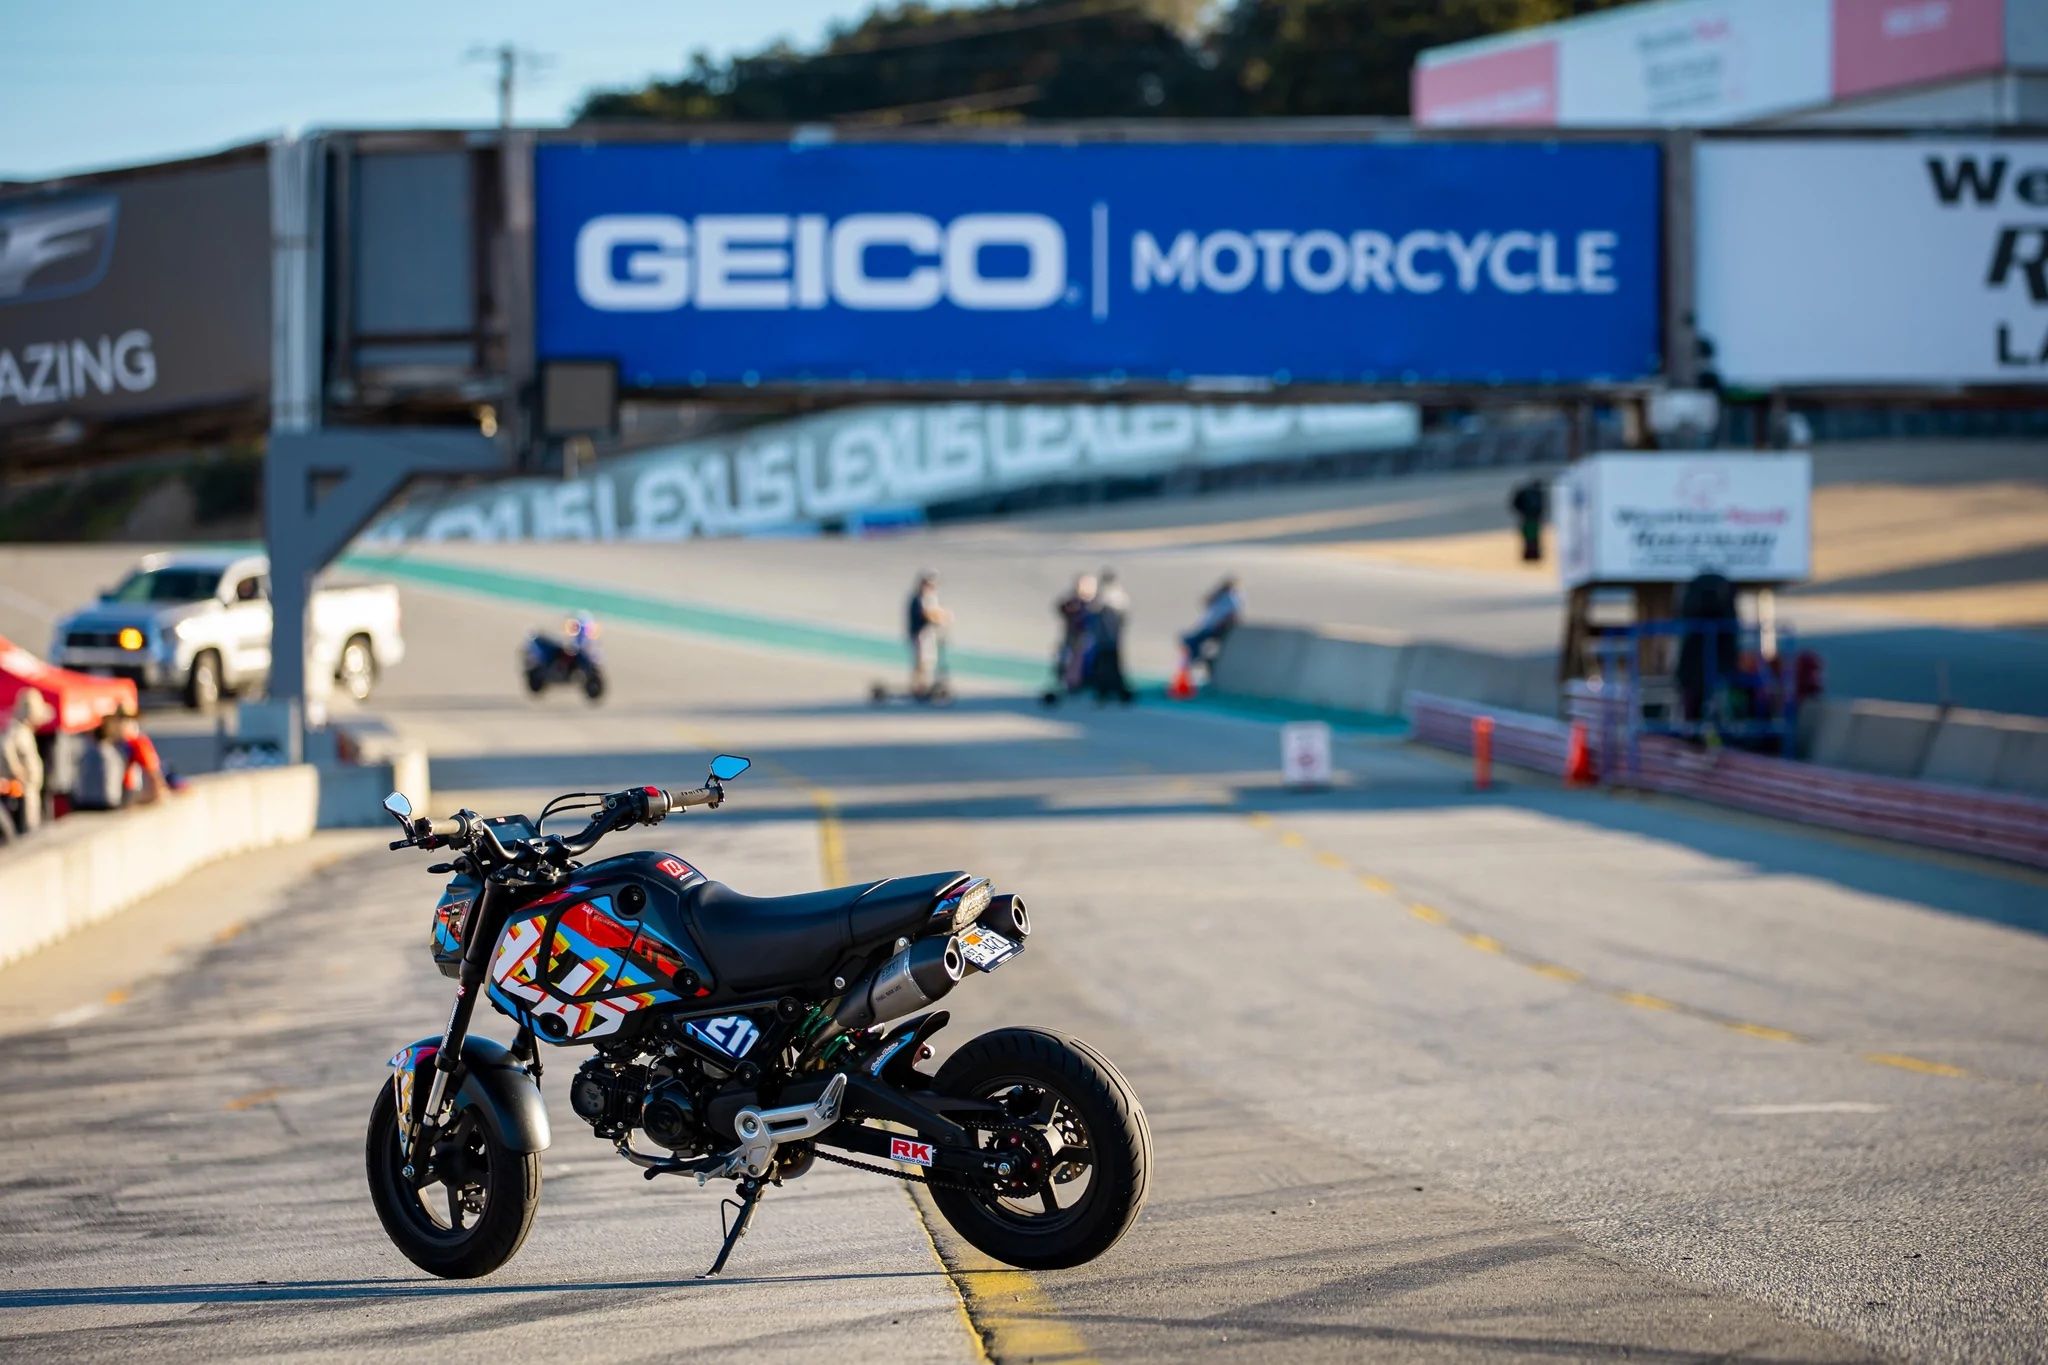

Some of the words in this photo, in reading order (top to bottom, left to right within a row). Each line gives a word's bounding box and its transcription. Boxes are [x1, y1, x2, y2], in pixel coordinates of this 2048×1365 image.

[575, 212, 1067, 312] GEICO
[1131, 230, 1618, 294] MOTORCYCLE
[0, 328, 157, 405] AZING
[892, 1139, 931, 1161] RK
